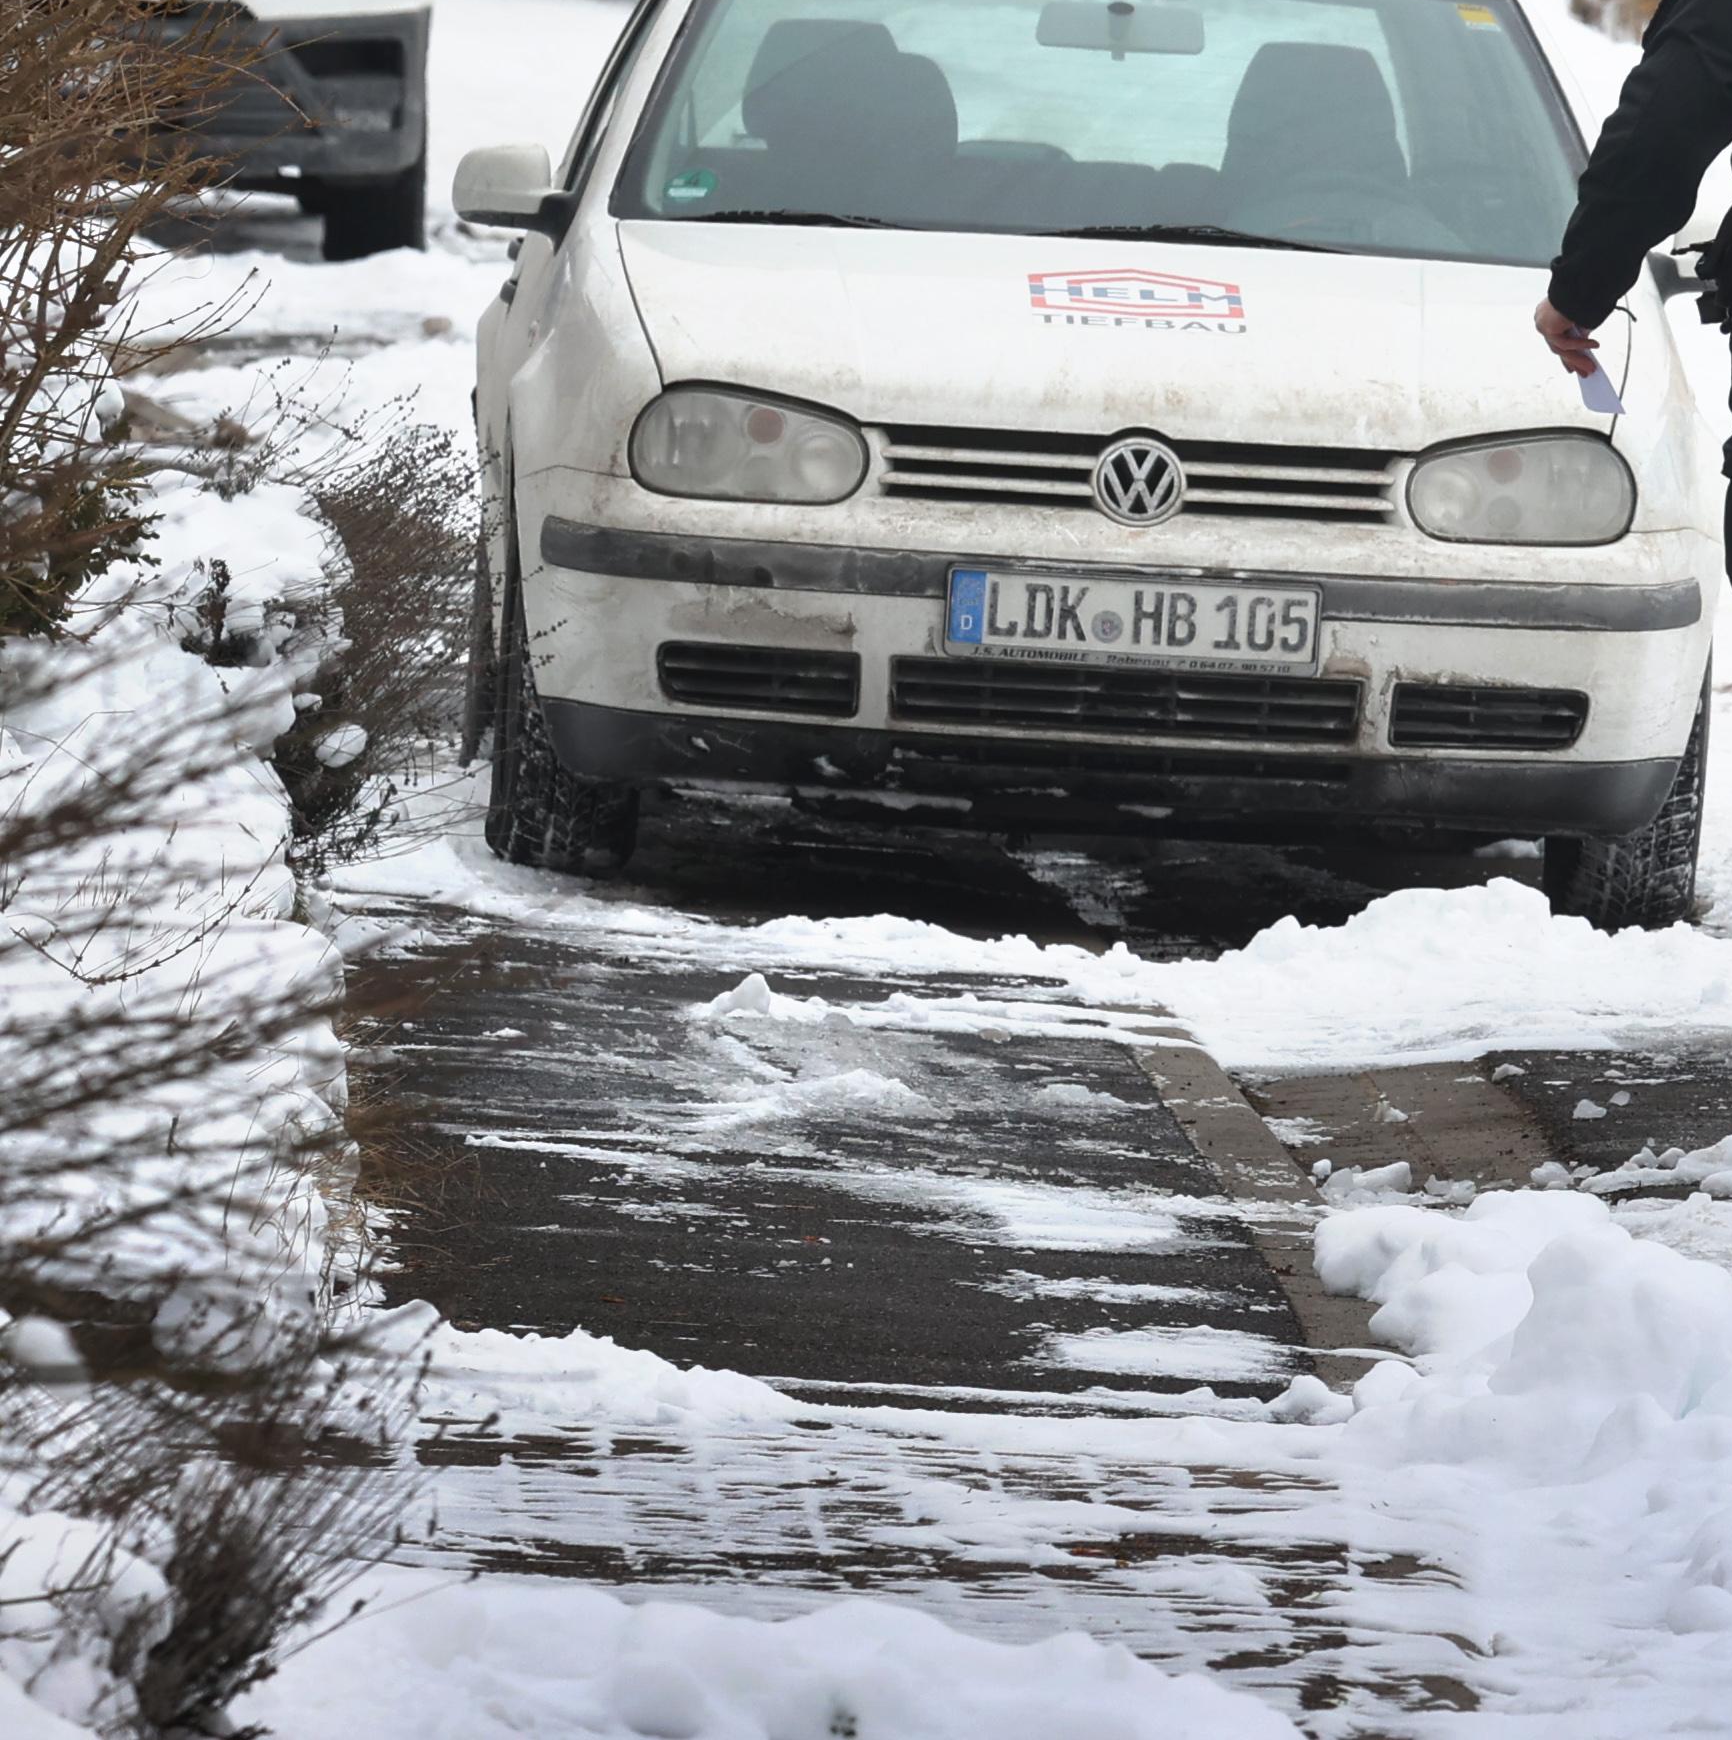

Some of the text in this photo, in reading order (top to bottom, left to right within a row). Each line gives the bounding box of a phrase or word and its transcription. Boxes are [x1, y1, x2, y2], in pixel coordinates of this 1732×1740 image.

[1028, 272, 1244, 317] HELM
[1032, 313, 1247, 334] TIEFBAU
[960, 614, 973, 631] D
[987, 580, 1309, 653] LDK HB 105
[1000, 647, 1090, 662] AUTOMOBILE
